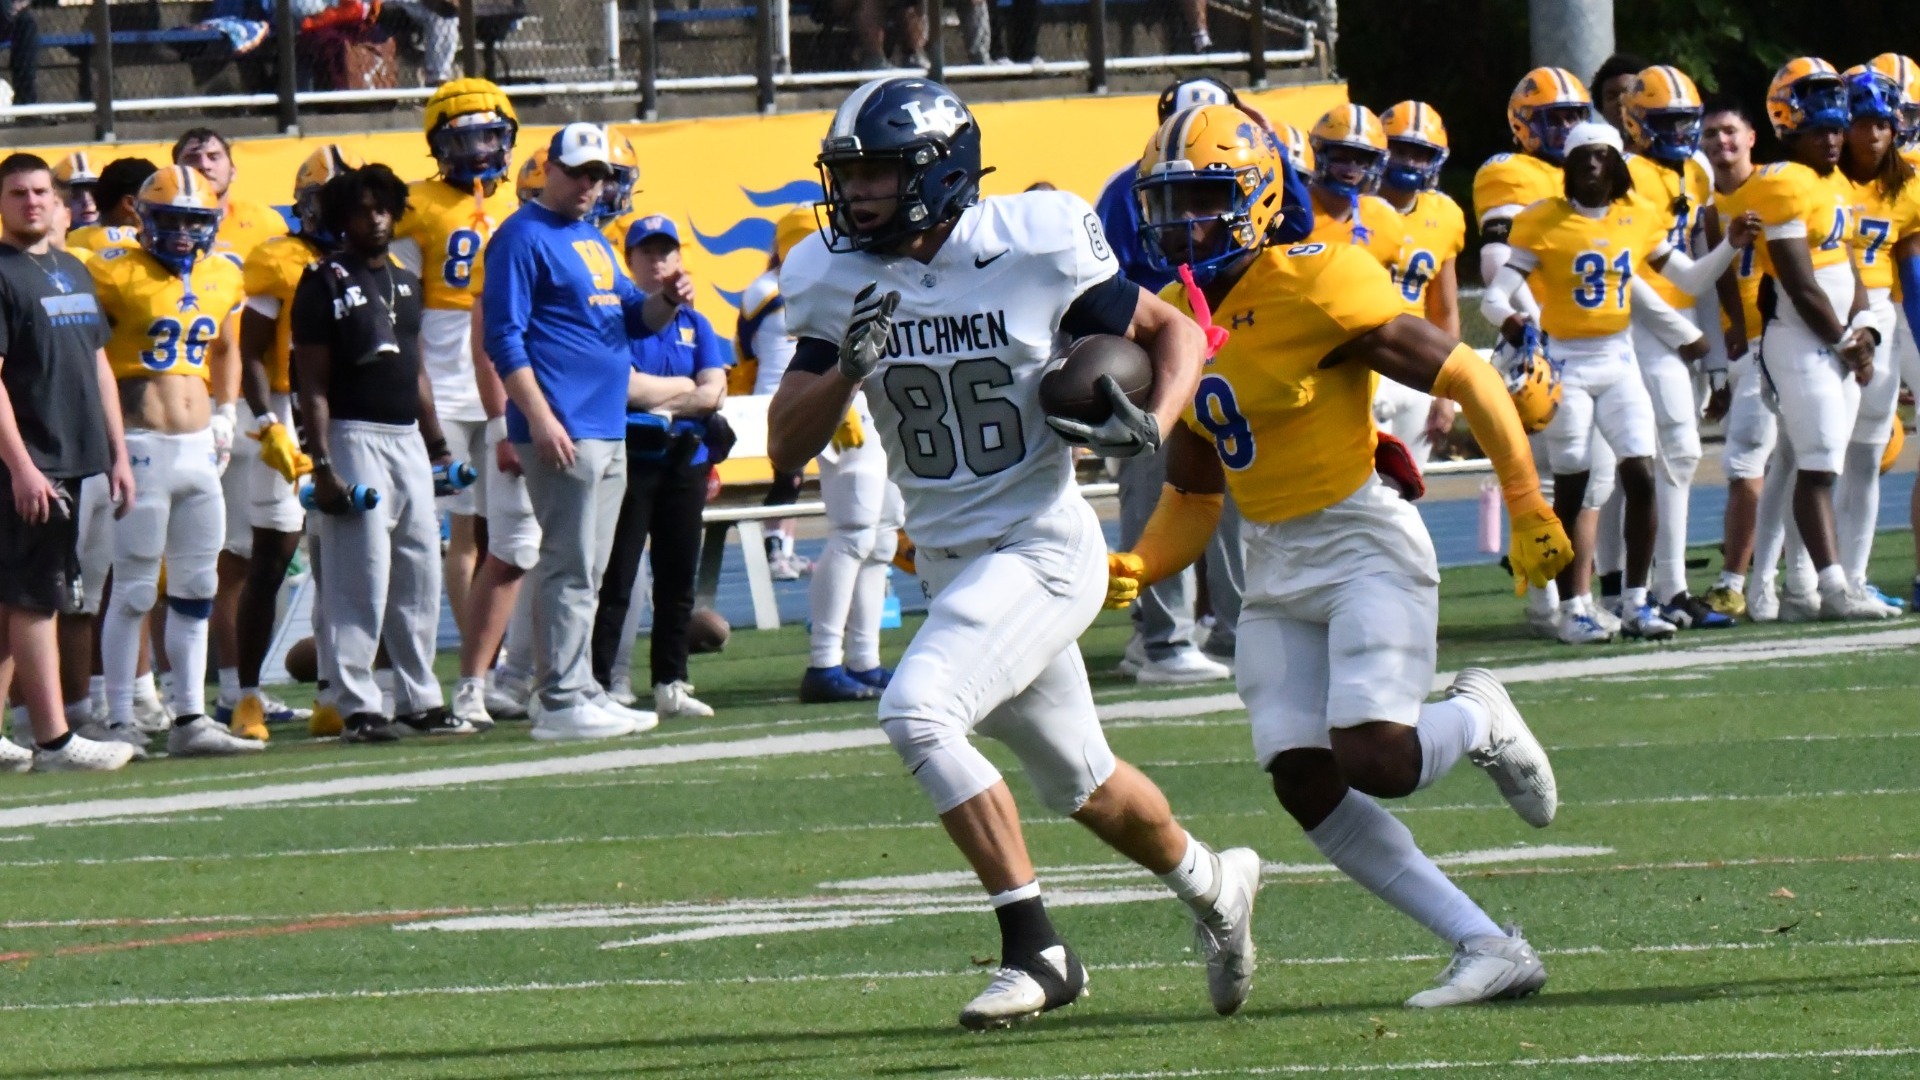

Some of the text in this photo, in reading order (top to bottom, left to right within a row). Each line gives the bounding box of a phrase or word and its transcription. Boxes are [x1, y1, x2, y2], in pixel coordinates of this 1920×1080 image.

[1391, 248, 1436, 304] 6
[1572, 249, 1632, 310] 31
[138, 314, 217, 372] 36
[879, 309, 1009, 359] UTCHMEN
[883, 356, 1027, 480] 86
